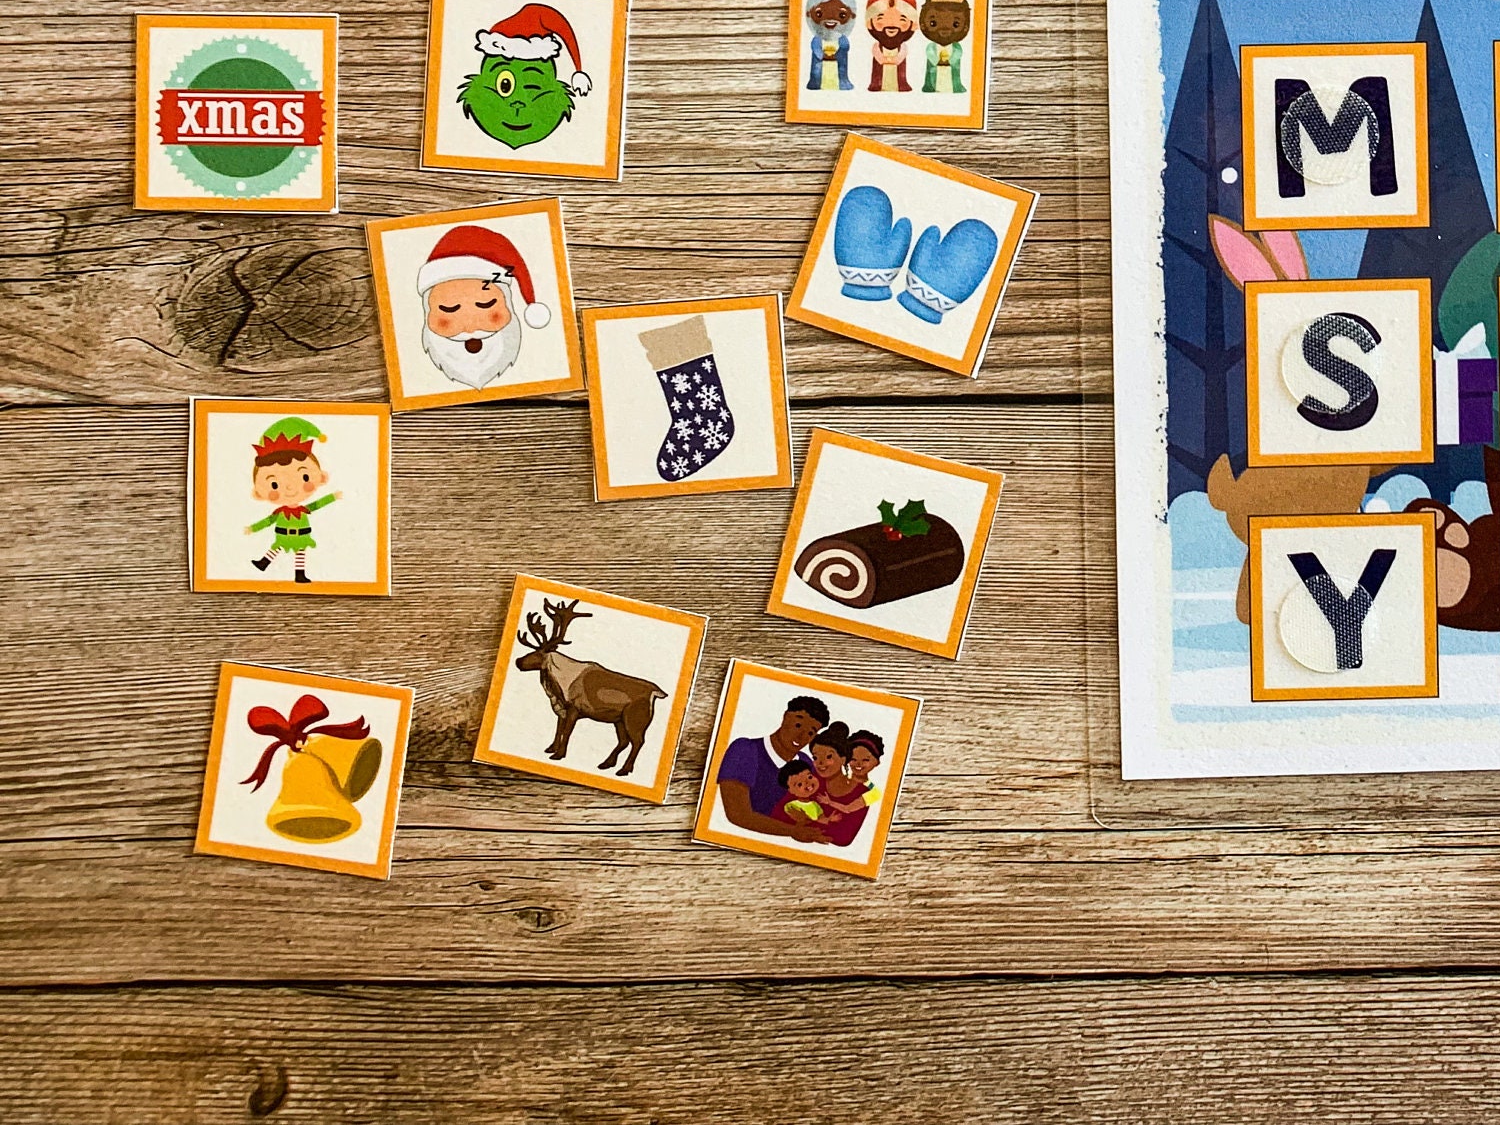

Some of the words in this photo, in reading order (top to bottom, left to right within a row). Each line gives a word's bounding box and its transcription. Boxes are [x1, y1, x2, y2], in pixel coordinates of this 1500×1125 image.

[177, 100, 304, 136] xmas
[1275, 77, 1398, 198] M
[1297, 313, 1381, 431] S
[1287, 549, 1396, 670] Y
